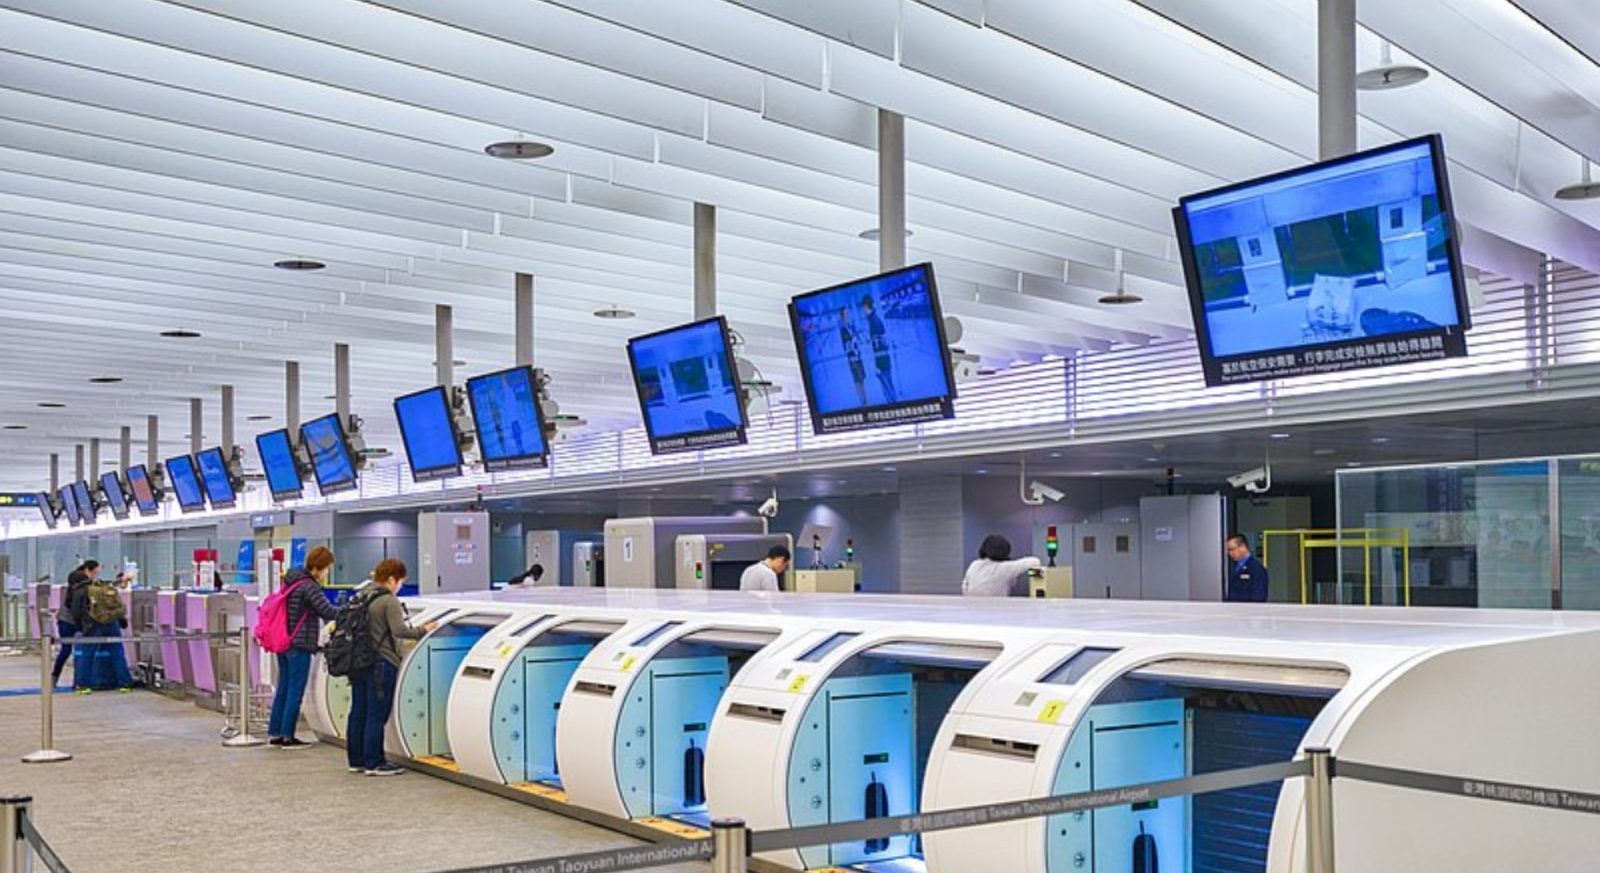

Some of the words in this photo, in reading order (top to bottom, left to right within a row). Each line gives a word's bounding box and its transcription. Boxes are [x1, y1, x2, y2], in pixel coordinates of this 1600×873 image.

[1120, 787, 1149, 802] Airport
[558, 856, 615, 873] Taoyuan
[617, 841, 699, 866] International
